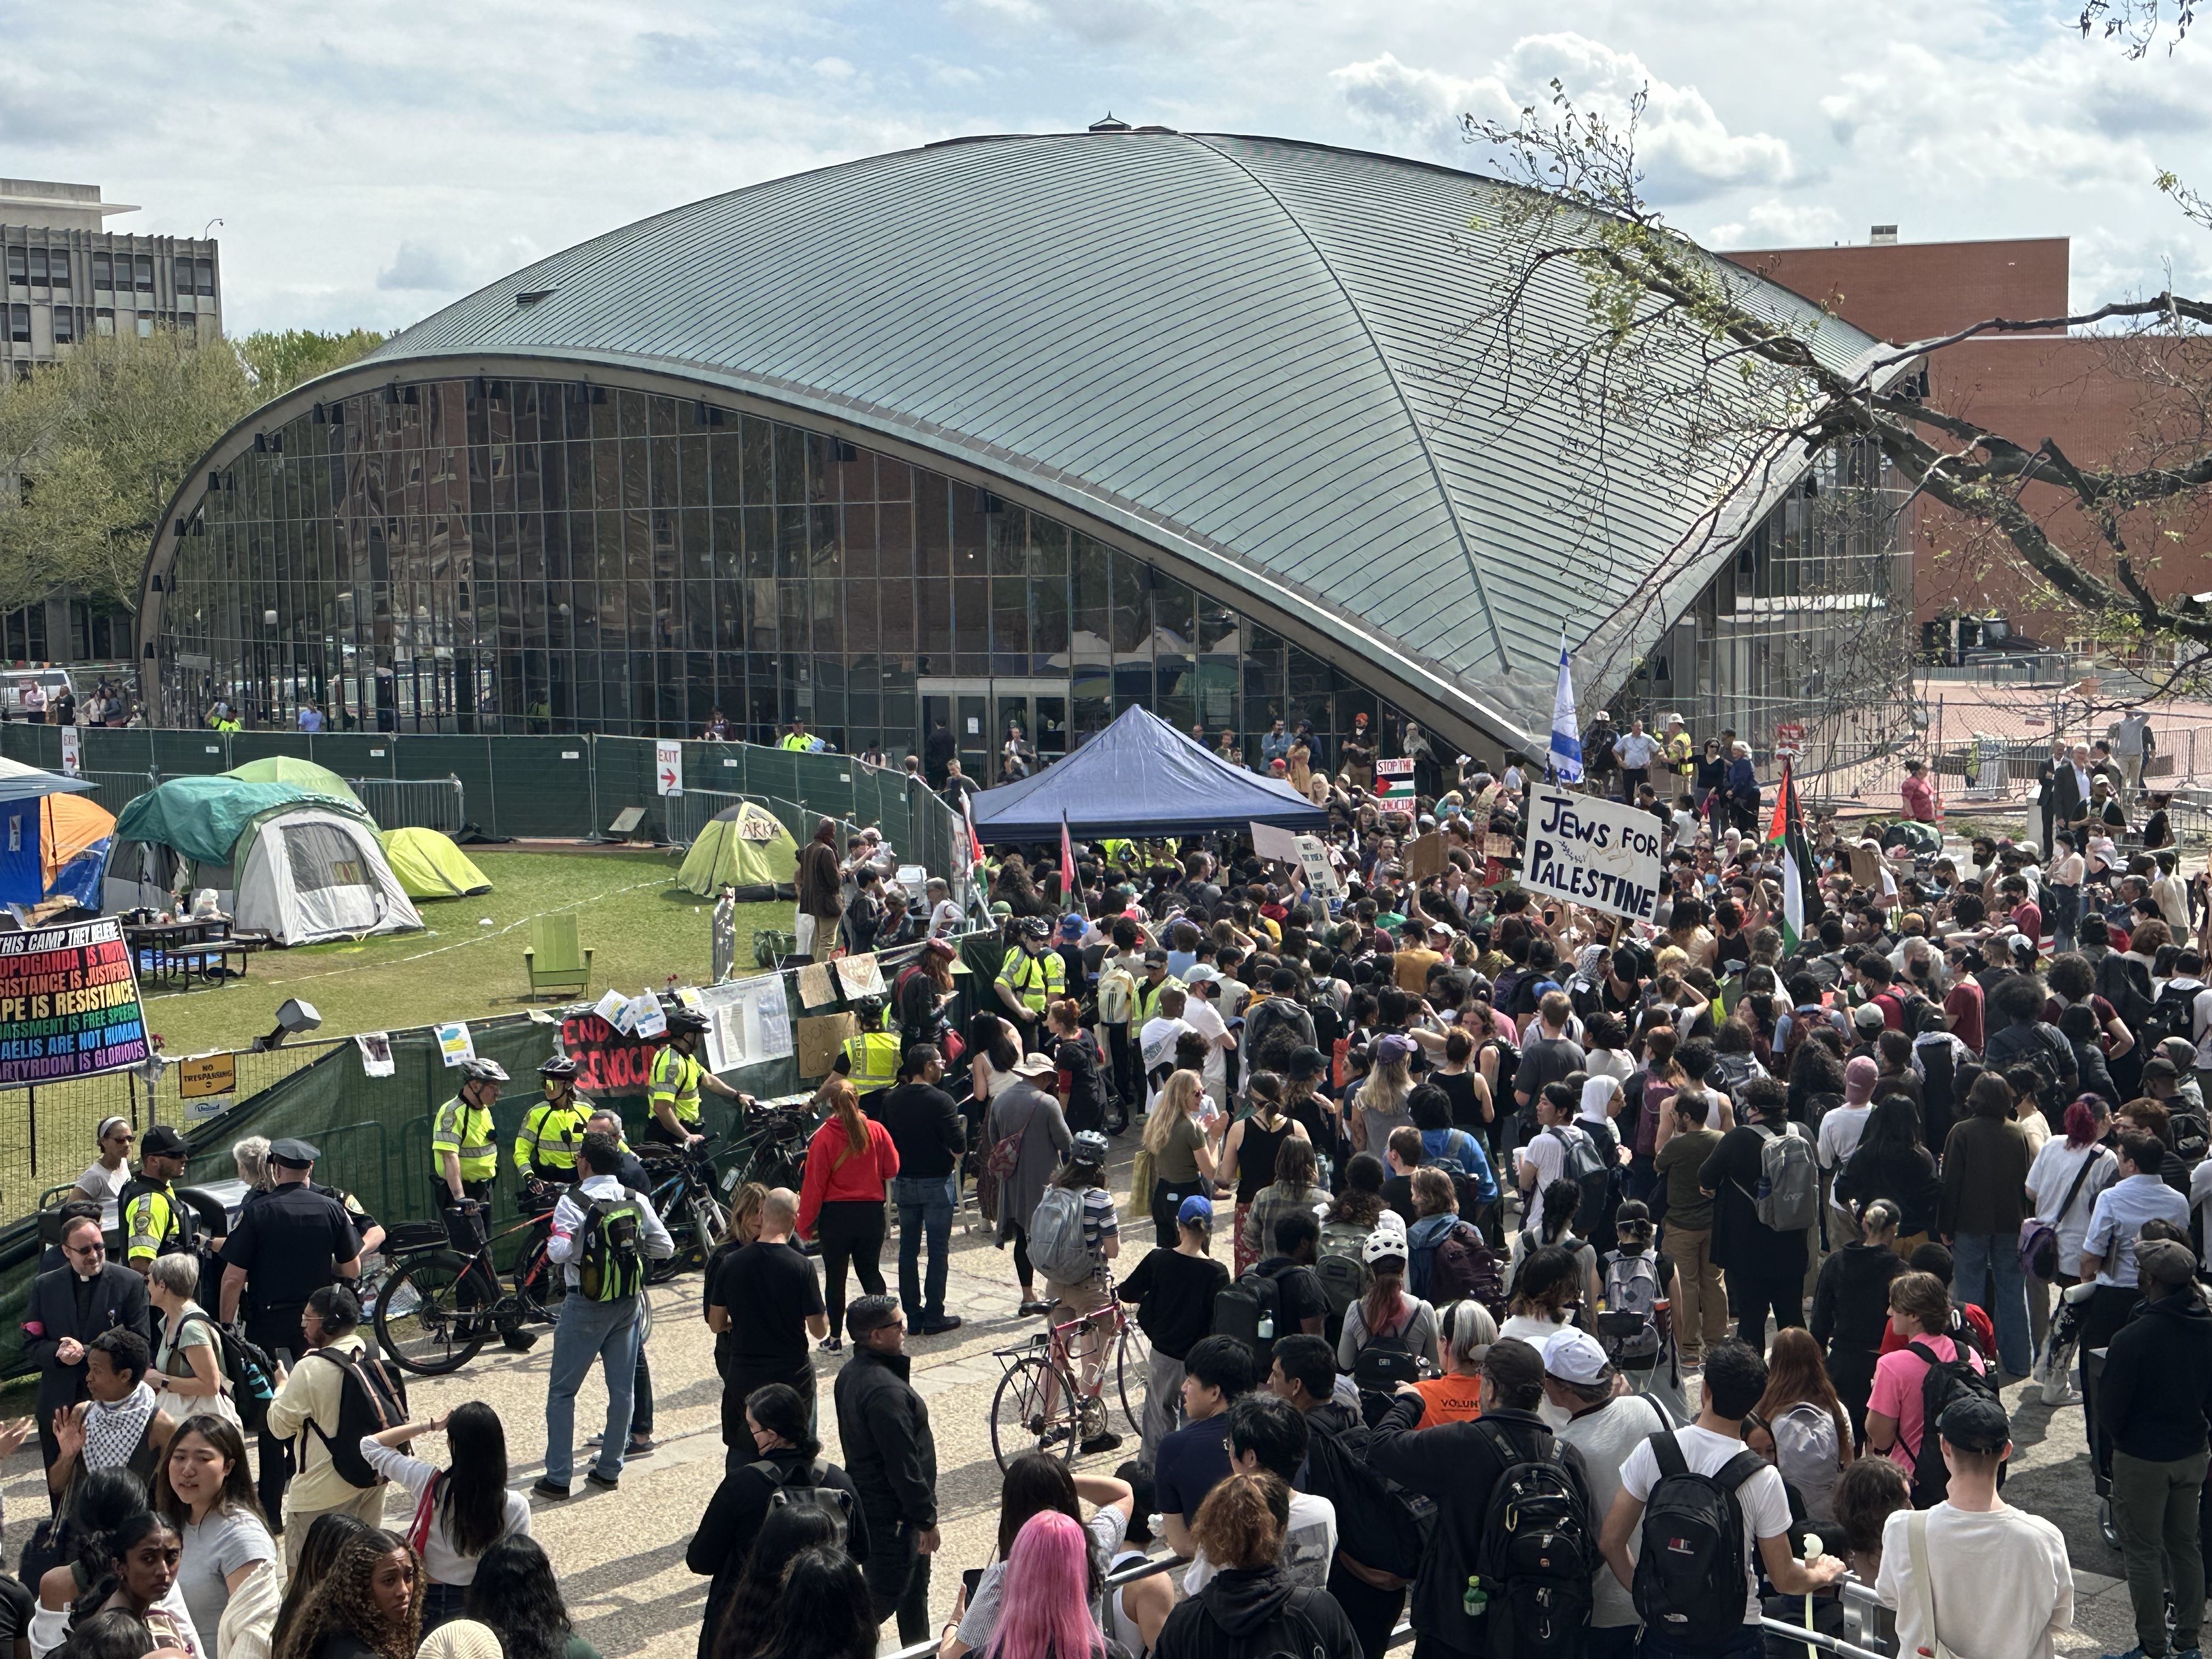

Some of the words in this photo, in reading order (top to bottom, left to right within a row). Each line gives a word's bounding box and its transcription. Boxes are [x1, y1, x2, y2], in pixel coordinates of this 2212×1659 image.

[658, 749, 678, 763] EXIT
[1378, 761, 1397, 772] STOP
[1398, 760, 1411, 771] THE
[1541, 796, 1610, 848] JEWS
[1622, 827, 1658, 858] FOR
[1530, 839, 1656, 917] PALESTINE
[28, 930, 65, 952] CAMP
[68, 926, 90, 946] THEY
[86, 946, 97, 967] IS
[70, 970, 82, 989] IS
[86, 961, 131, 986] JUSTIFIED
[0, 997, 26, 1022] PE
[32, 995, 49, 1019] IS
[55, 979, 136, 1016] RESISTANCE
[0, 1018, 65, 1040] ASSMENT
[68, 1015, 80, 1032] IS
[83, 1010, 106, 1030] FREE
[108, 1003, 139, 1024] SPEECH
[563, 1017, 610, 1046] END
[48, 1034, 75, 1056] ARE
[79, 1030, 101, 1051] NOT
[104, 1020, 142, 1046] HUMAN
[0, 1054, 74, 1081] RTYRDOM
[79, 1052, 91, 1071] IS
[94, 1041, 145, 1068] GLORIOUS
[184, 1070, 233, 1082] TRESPASSING
